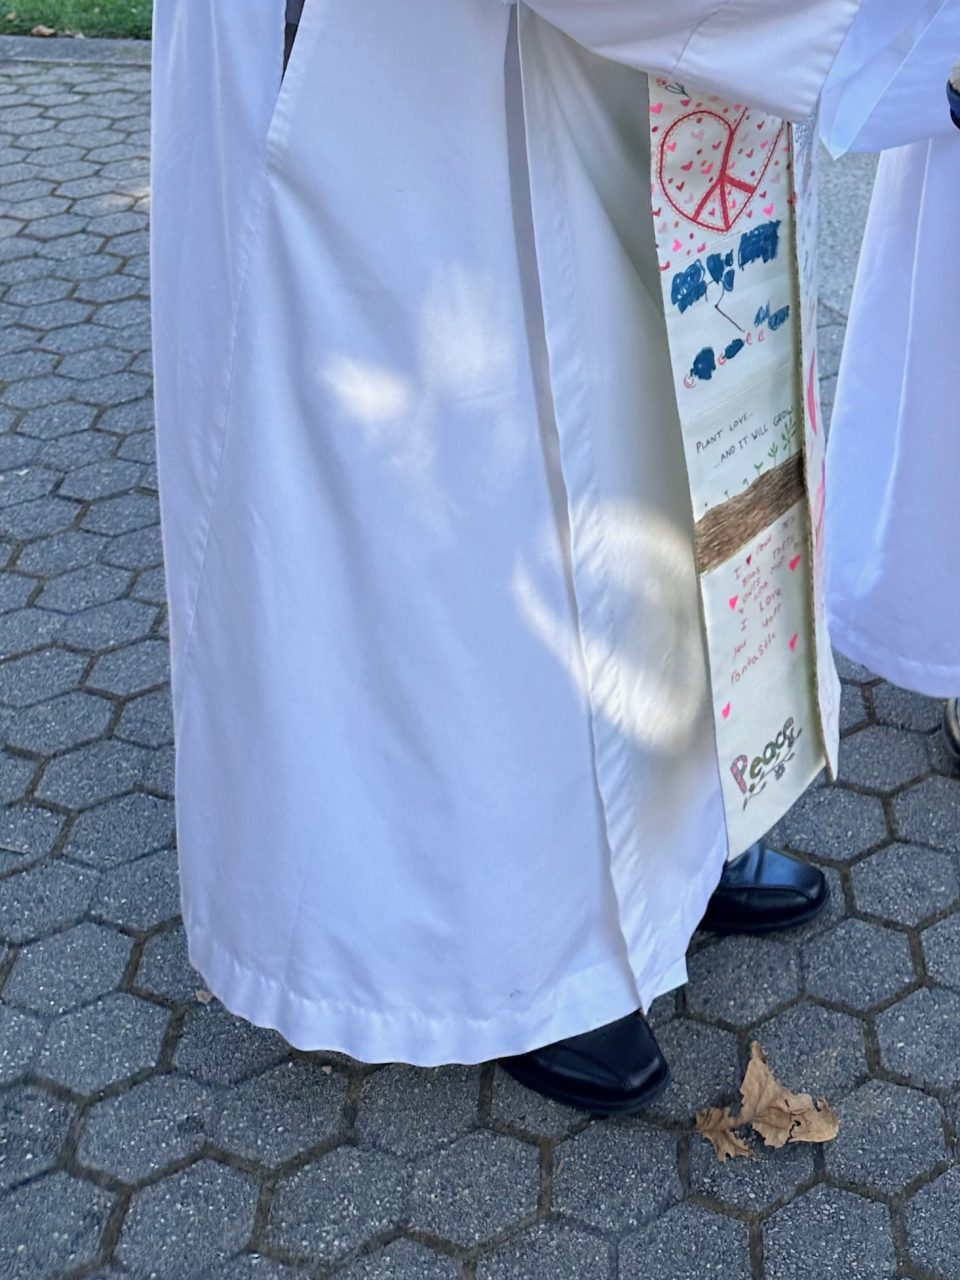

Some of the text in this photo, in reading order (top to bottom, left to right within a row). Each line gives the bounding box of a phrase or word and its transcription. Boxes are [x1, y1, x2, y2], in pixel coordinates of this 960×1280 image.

[696, 429, 723, 454] PLANT
[739, 435, 748, 450] IT
[751, 423, 769, 440] WILL
[730, 716, 794, 794] Peace
